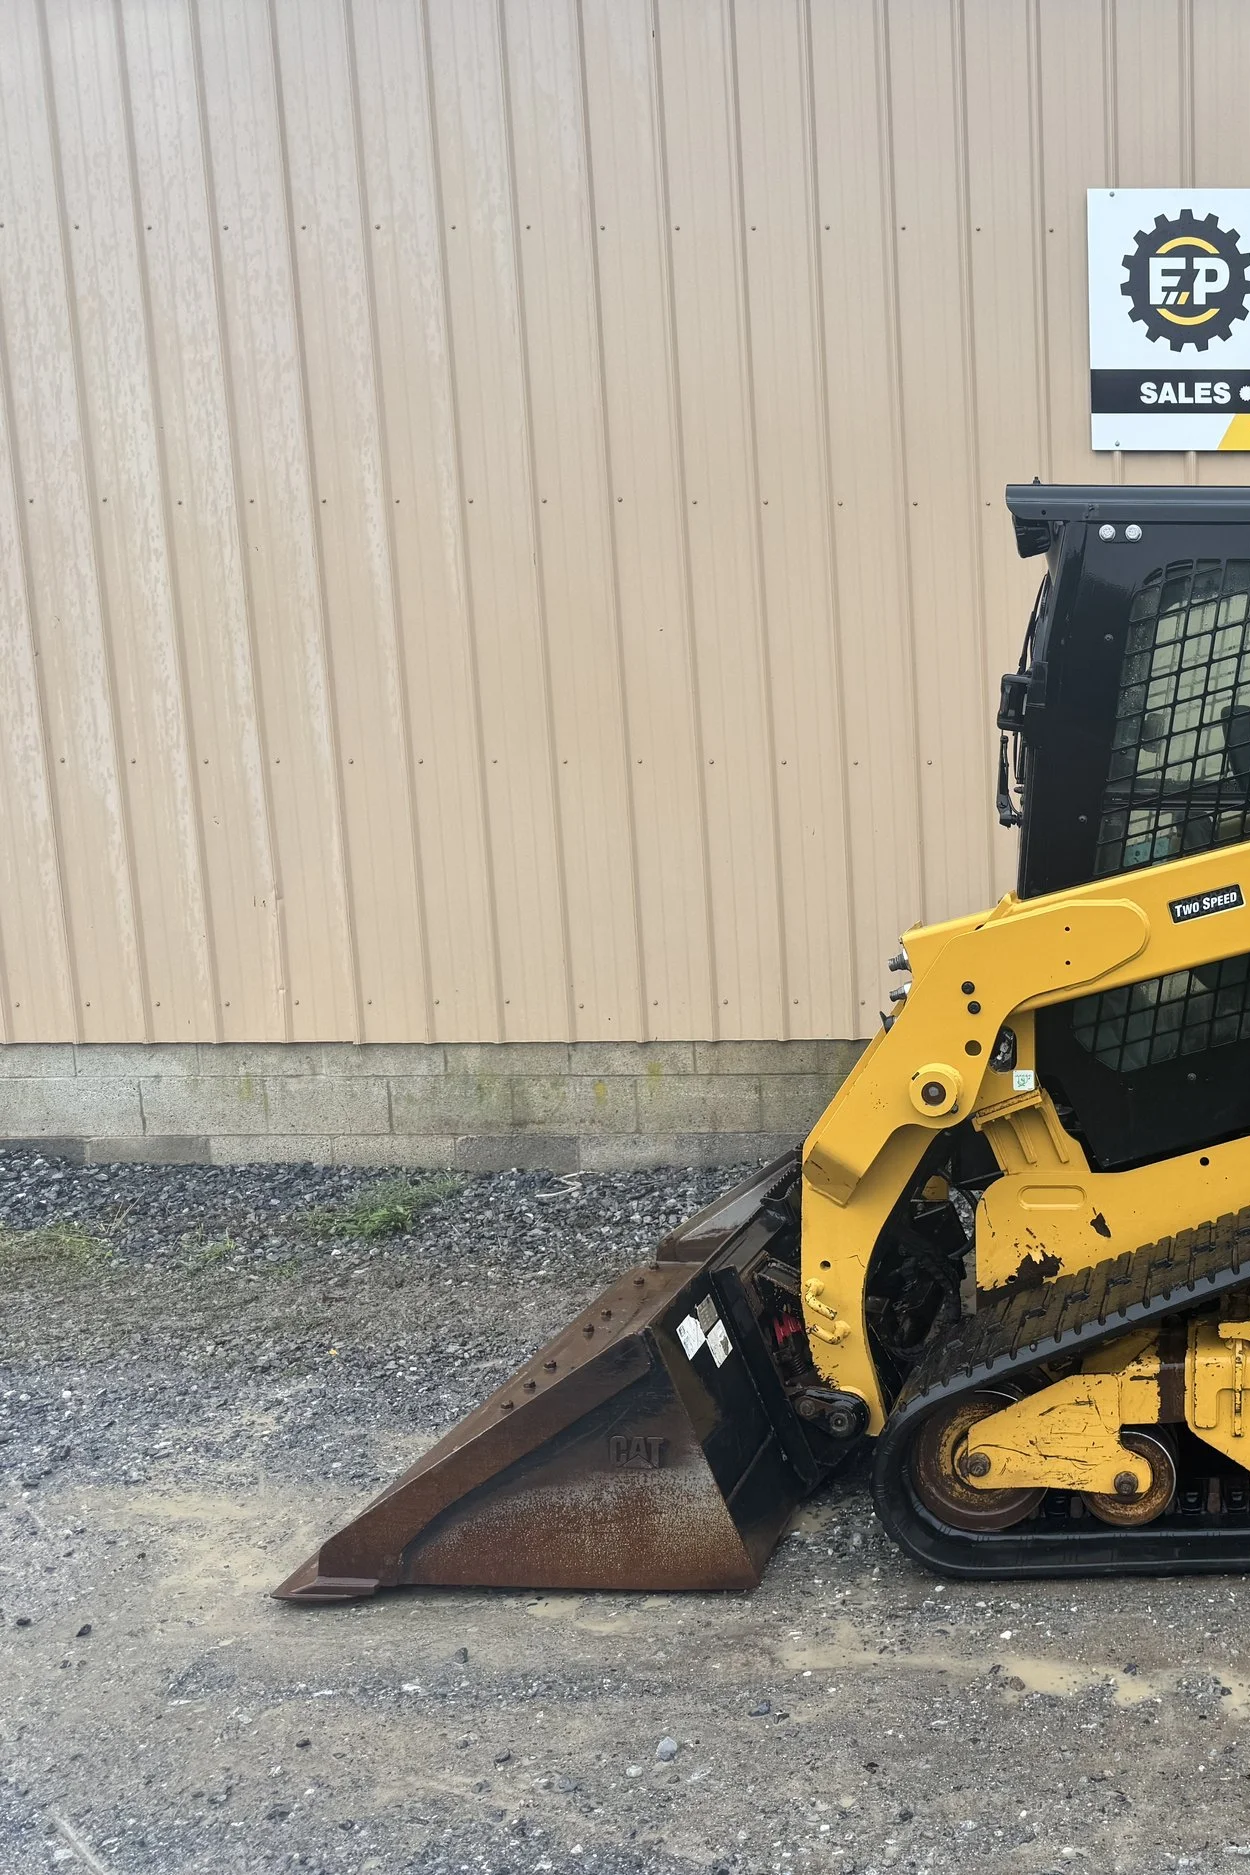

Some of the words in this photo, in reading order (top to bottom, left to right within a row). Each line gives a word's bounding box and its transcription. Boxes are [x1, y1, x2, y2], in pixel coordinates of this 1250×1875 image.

[1140, 382, 1231, 404] SALES
[1174, 902, 1200, 918] TWO
[1202, 891, 1237, 910] SPEED
[609, 1435, 664, 1469] CAT
